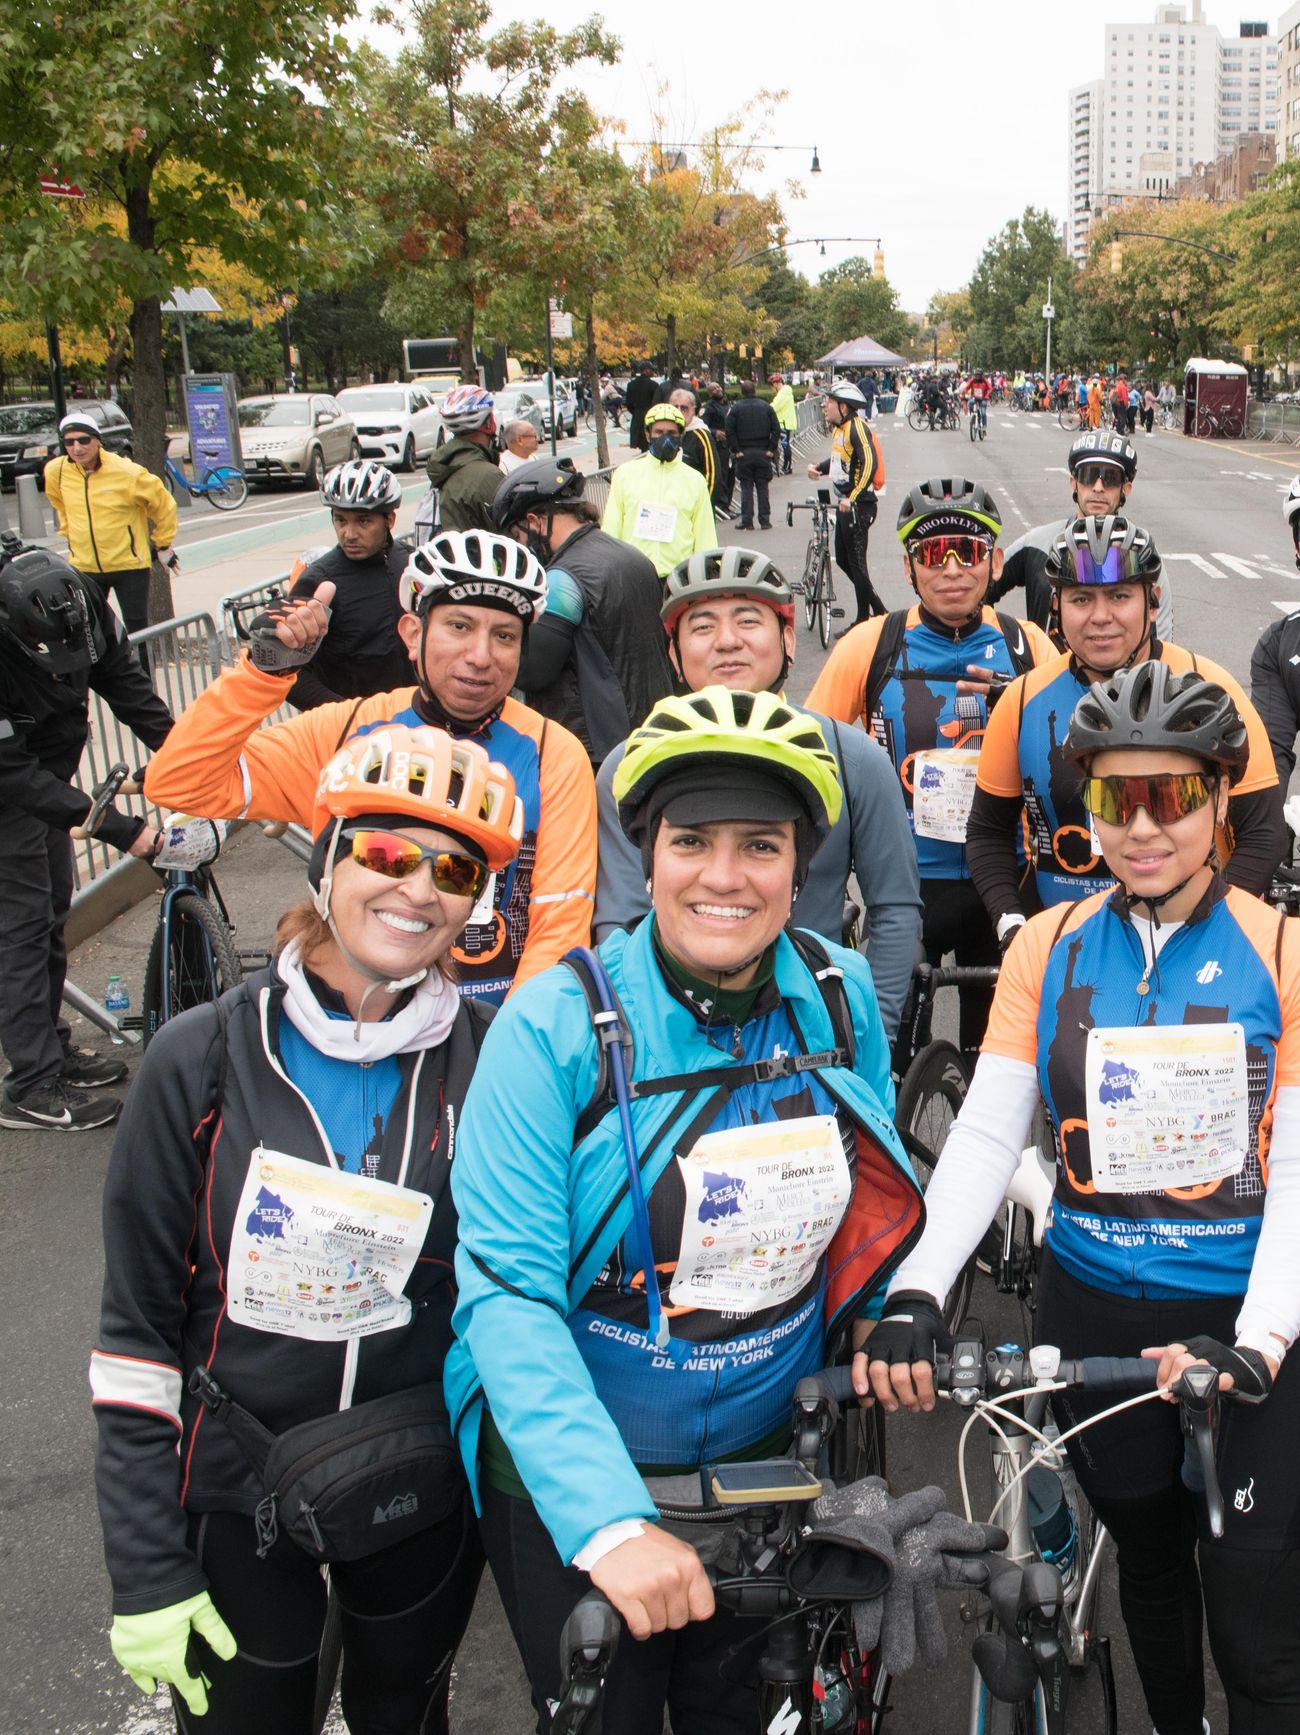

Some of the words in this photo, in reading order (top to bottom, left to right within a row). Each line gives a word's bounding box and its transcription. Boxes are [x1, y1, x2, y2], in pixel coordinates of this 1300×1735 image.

[916, 516, 982, 536] BROOKLYN
[448, 582, 533, 615] QUEENS
[1054, 876, 1091, 887] CICLISTAS
[1152, 1062, 1176, 1070] TOUR
[1176, 1068, 1211, 1078] BRONX
[1214, 1068, 1235, 1076] 2022
[1146, 1116, 1185, 1128] NYBG
[1210, 1110, 1236, 1123] BRAC
[757, 1162, 780, 1177] TOUR
[781, 1161, 794, 1171] DE
[781, 1166, 815, 1181] BRONX
[818, 1164, 835, 1174] 2022
[807, 1176, 834, 1187] Einstein
[254, 1208, 282, 1217] LET'S
[310, 1205, 338, 1220] TOUR
[338, 1212, 354, 1224] DE
[812, 1216, 834, 1231] BRAC
[1105, 1219, 1246, 1237] LATINOAMERICANOS
[333, 1222, 379, 1240] BRONX
[380, 1233, 406, 1246] 2022
[749, 1226, 792, 1244] NYBG
[1112, 1234, 1146, 1247] NEW
[1150, 1236, 1189, 1249] YORK
[292, 1261, 339, 1279] NYBG
[652, 1356, 676, 1370] DE
[682, 1358, 726, 1372] NEW
[730, 1344, 775, 1368] YORK
[1234, 1488, 1247, 1511] GEL
